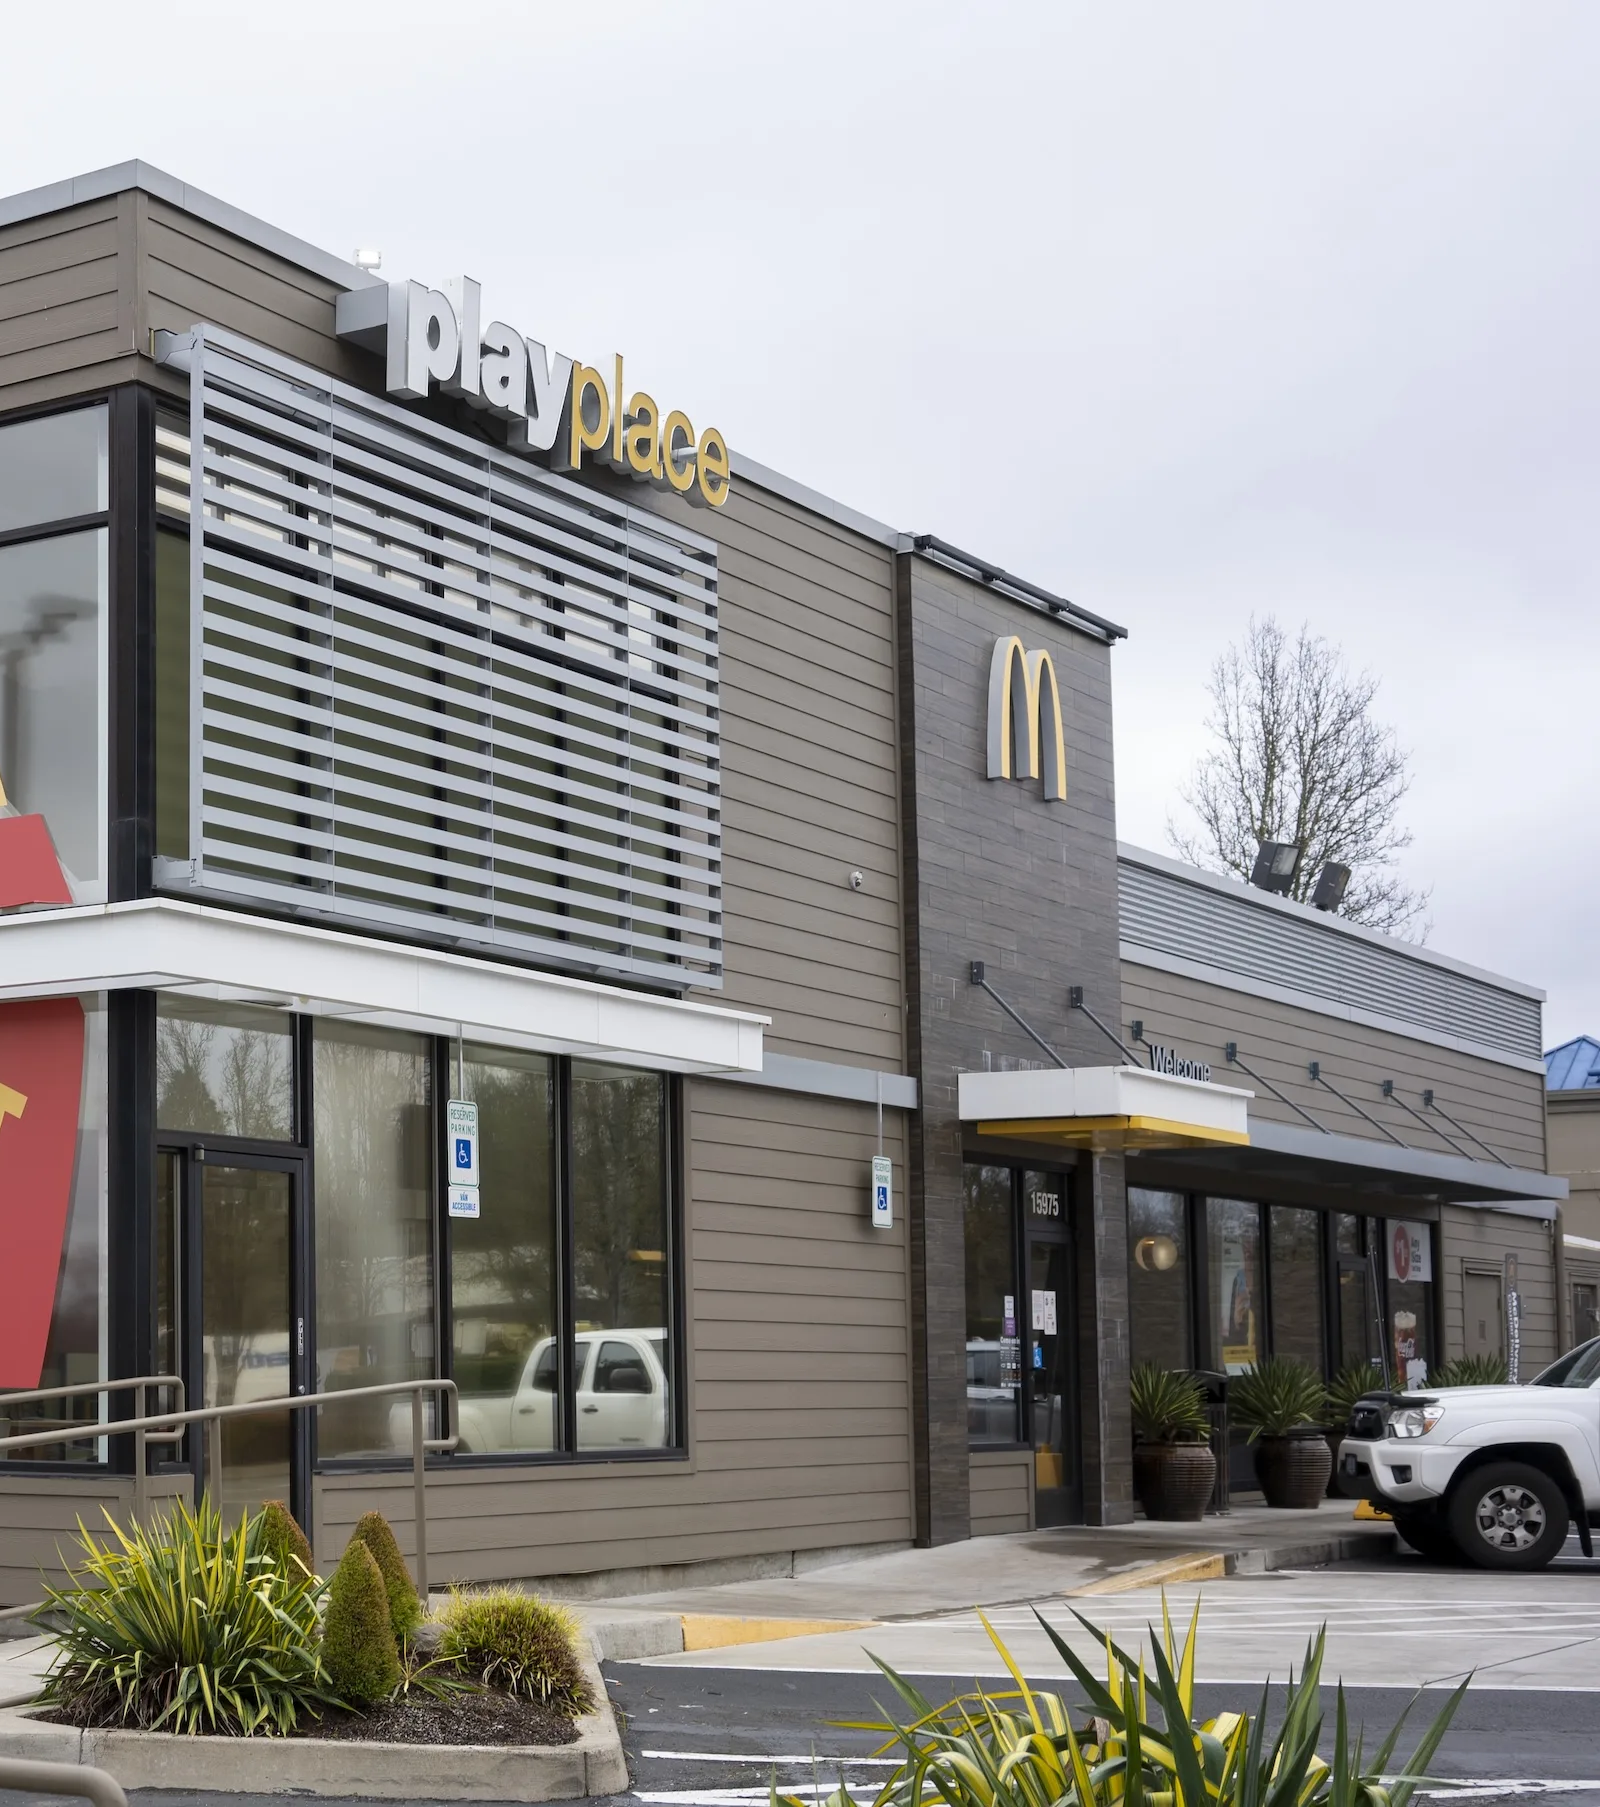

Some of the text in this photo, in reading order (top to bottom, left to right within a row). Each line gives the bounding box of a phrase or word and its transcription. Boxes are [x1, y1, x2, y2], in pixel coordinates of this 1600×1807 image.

[1149, 1045, 1211, 1082] Welcome
[450, 1109, 475, 1121] RESERVED
[450, 1123, 476, 1136] PARKING
[460, 1193, 468, 1201] VAN
[452, 1201, 476, 1212] ACCESSIBLE
[1031, 1191, 1059, 1216] 15975
